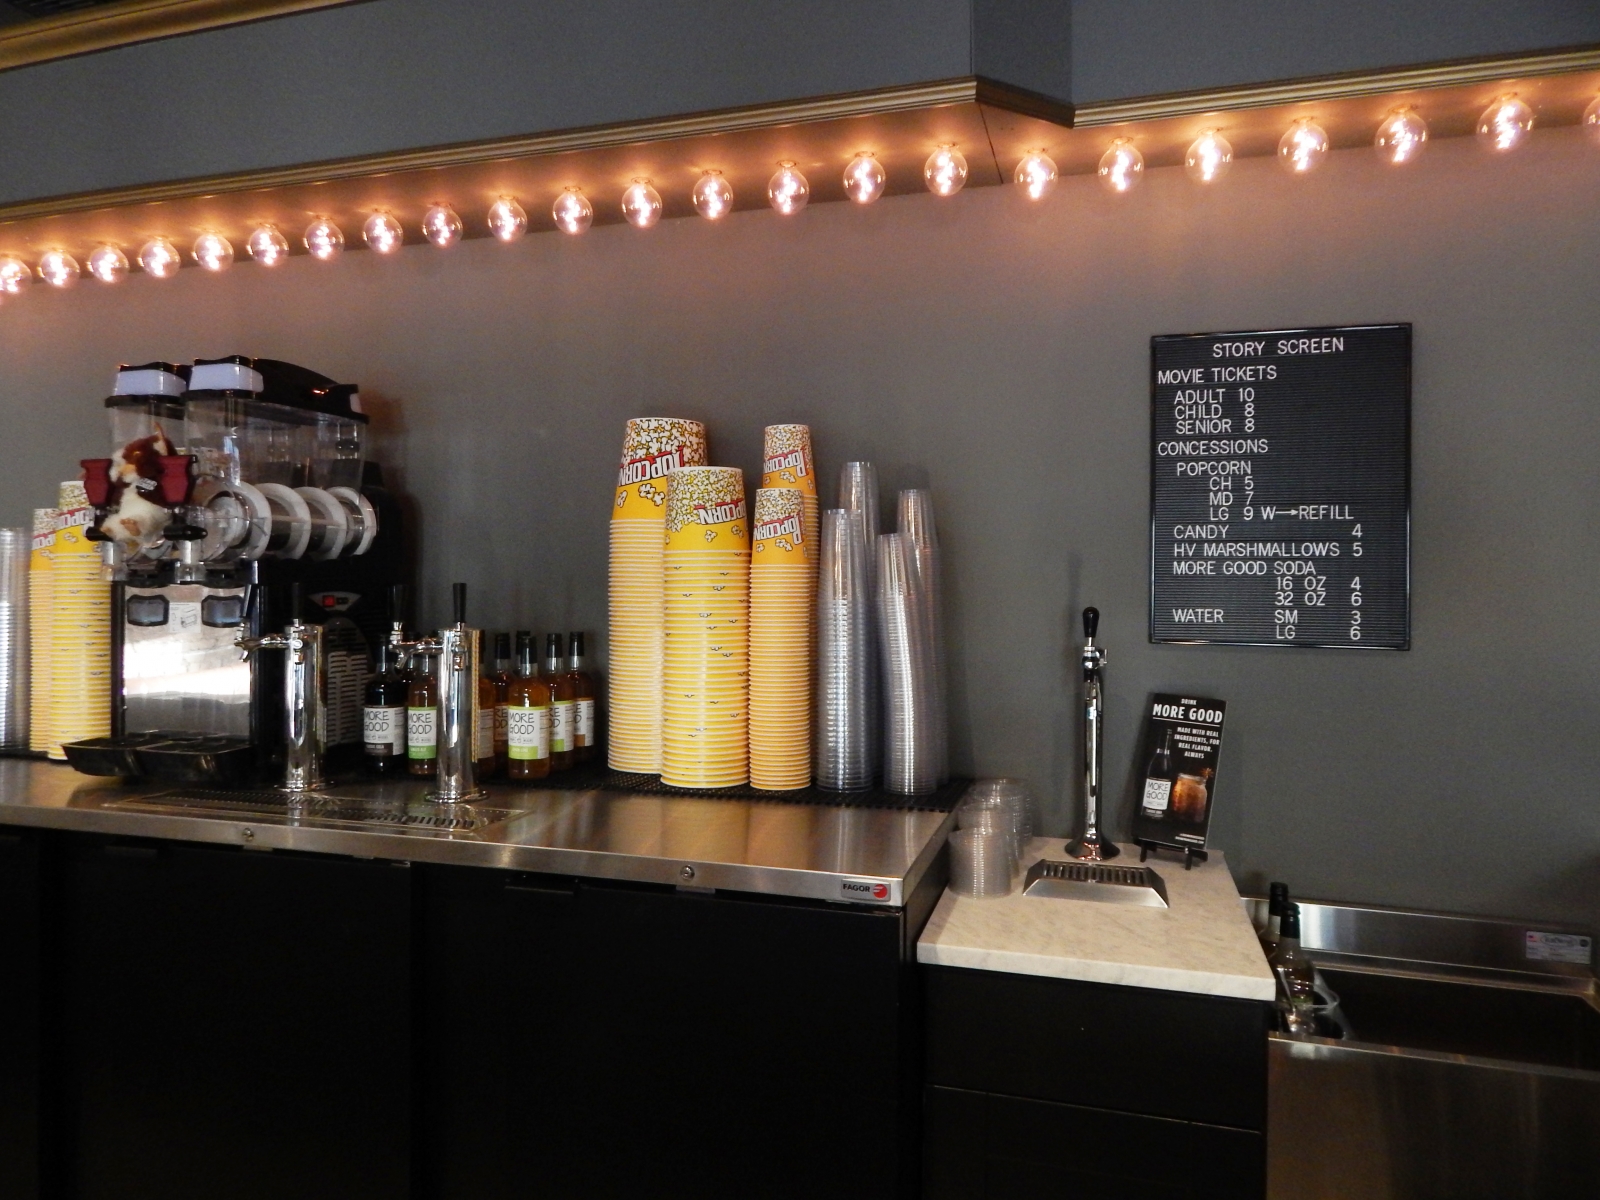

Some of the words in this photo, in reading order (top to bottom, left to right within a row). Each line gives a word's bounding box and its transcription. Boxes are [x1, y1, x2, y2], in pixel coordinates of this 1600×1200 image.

[1212, 342, 1266, 358] STORY
[1277, 337, 1344, 355] SCREEN
[1158, 369, 1205, 384] MOVIE
[1212, 365, 1277, 382] TICKETS
[1174, 389, 1226, 404] ADULT
[1238, 388, 1255, 402] 10
[1174, 404, 1222, 420] CHILD
[1245, 403, 1255, 417] 8
[1176, 419, 1232, 434] SENIOR
[1245, 418, 1255, 432] 8
[1158, 439, 1269, 456] CONCESSIONS
[763, 450, 807, 478] POPCORN
[1177, 461, 1251, 476] POPCORN
[1210, 477, 1232, 491] CH
[1244, 476, 1254, 490] 5
[1209, 492, 1233, 506] MD
[1245, 492, 1254, 505] 7
[700, 502, 746, 524] OPCORN
[1210, 507, 1229, 521] LG
[1243, 507, 1254, 520] 9
[1299, 505, 1354, 520] REFILL
[754, 514, 802, 545] POPCORN
[1174, 525, 1229, 539] CANDY
[1352, 524, 1362, 538] 4
[1174, 543, 1196, 557] HV
[1204, 542, 1340, 557] MARSHMALLOWS
[1353, 543, 1362, 557] 5
[1173, 561, 1216, 575] MORE
[1223, 561, 1267, 575] GOOD
[1274, 561, 1316, 575] SODA
[1277, 577, 1293, 591] 16
[1304, 577, 1326, 591] OZ
[1351, 576, 1362, 591] 4
[1275, 592, 1294, 606] 32
[1304, 592, 1326, 606] OZ
[1351, 592, 1362, 606] 6
[1173, 609, 1223, 623] WATER
[1274, 610, 1298, 623] SM
[1351, 611, 1361, 625] 3
[1276, 626, 1296, 639] LG
[1351, 626, 1361, 640] 6
[1181, 698, 1197, 706] DRINK
[1152, 704, 1185, 719] MORE
[1189, 708, 1223, 723] GOOD
[1192, 728, 1206, 736] WITH
[1206, 730, 1219, 738] REAL
[1178, 742, 1192, 750] REAL
[1184, 751, 1205, 759] ALWAYS
[1148, 781, 1168, 792] MORE
[1146, 790, 1168, 801] GOOD
[843, 884, 870, 892] FAGOR
